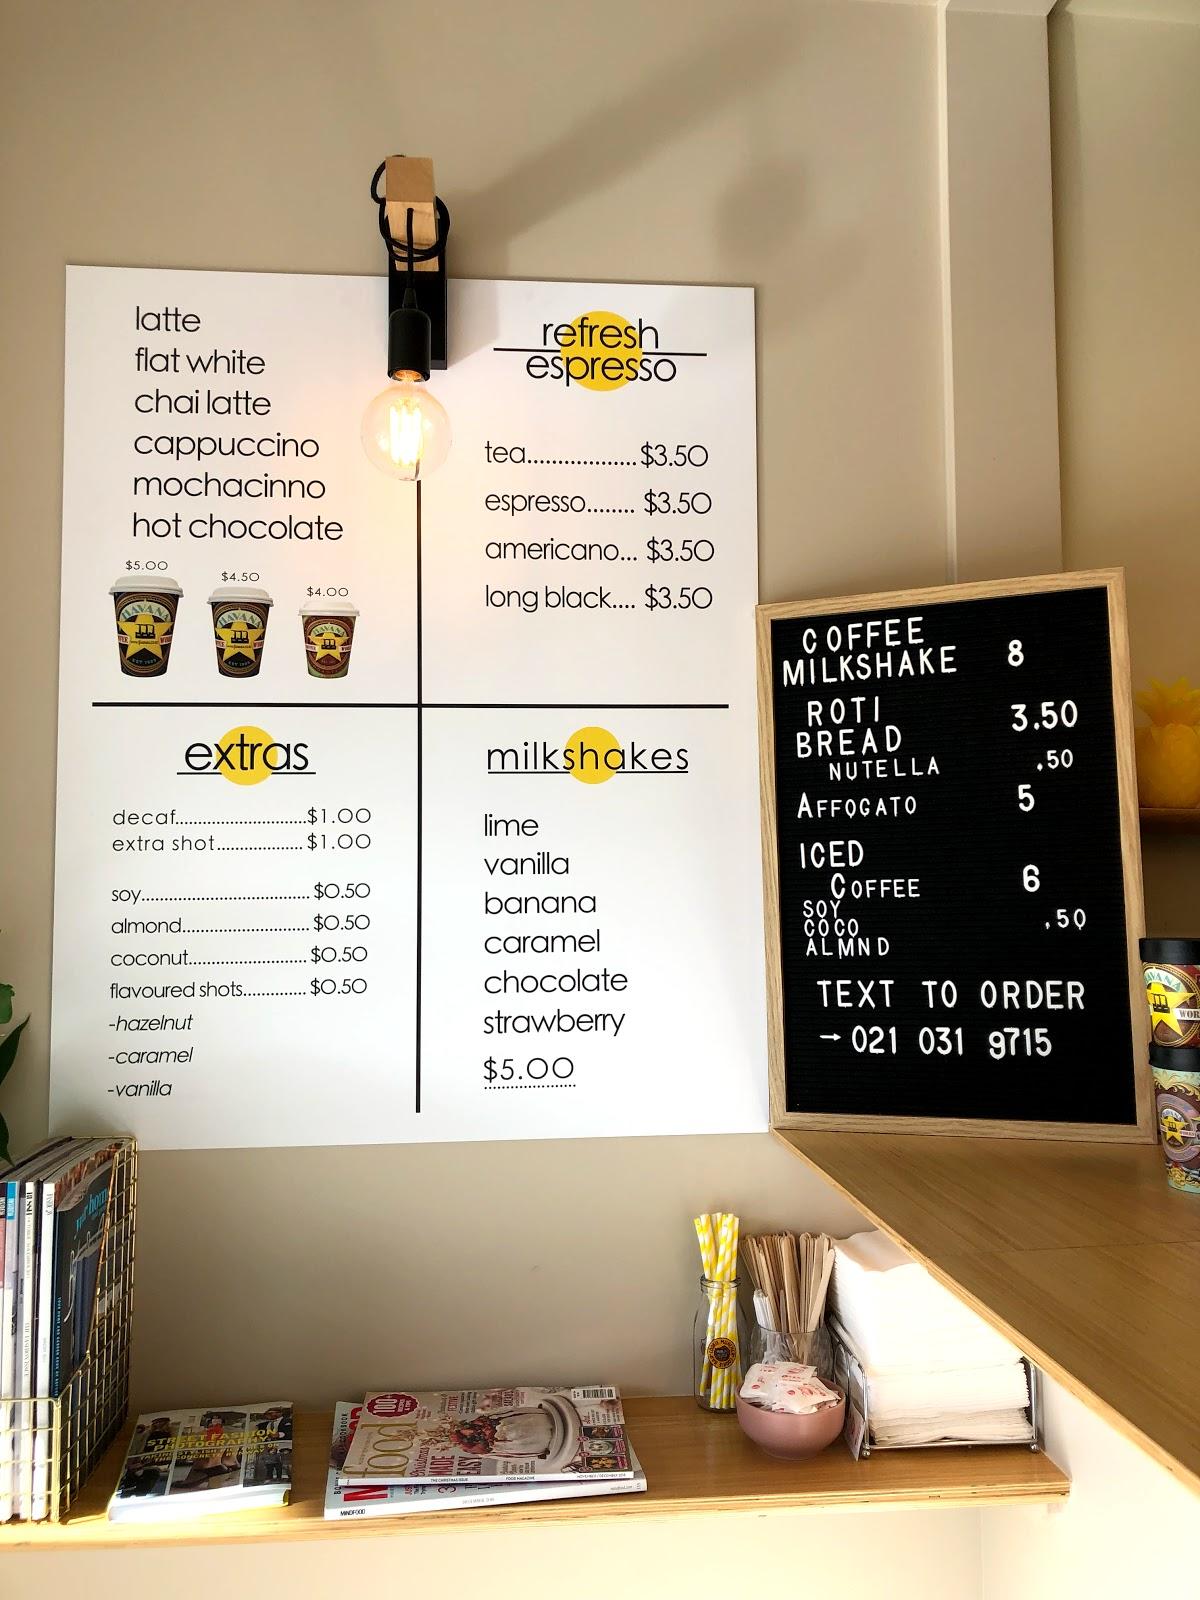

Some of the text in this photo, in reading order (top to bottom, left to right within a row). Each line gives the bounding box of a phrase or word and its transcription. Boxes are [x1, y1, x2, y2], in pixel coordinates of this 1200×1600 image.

[136, 306, 200, 332] latte
[543, 317, 658, 349] refresh
[135, 347, 265, 374] flat white
[526, 354, 677, 387] espresso
[135, 389, 271, 415] chai latte
[134, 432, 319, 461] cappuccino
[641, 441, 708, 468] $3.50
[134, 472, 325, 498] mochacinno
[644, 489, 712, 516] $3.50
[134, 512, 343, 540] hot chocolate
[647, 536, 714, 563] $3.50
[126, 560, 168, 570] $5.00
[222, 571, 259, 581] $4.50
[307, 586, 348, 597] $4.00
[486, 585, 538, 613] long
[645, 584, 712, 611] $3.50
[802, 616, 924, 654] COFFEE
[783, 640, 1024, 687] MILKSHAKE 8
[807, 696, 880, 727] ROTI
[796, 700, 1077, 758] BREAD 3.50
[184, 733, 309, 771] extras
[488, 741, 689, 771] milkshakes
[829, 756, 940, 781] NUTELLA
[1018, 784, 1034, 812] 5
[307, 807, 371, 825] $1.00
[485, 814, 538, 836] lime
[113, 836, 163, 851] extra
[308, 833, 370, 851] $1.00
[801, 840, 863, 869] ICED
[484, 852, 568, 875] vanilla
[314, 882, 370, 900] $0.50
[1023, 864, 1040, 892] 6
[485, 892, 596, 914] banana
[803, 900, 841, 918] SOY
[314, 914, 370, 932] $0.50
[804, 918, 859, 938] COCO
[311, 946, 367, 964] $0.50
[485, 929, 599, 954] caramel
[110, 982, 195, 998] flavoured
[311, 978, 367, 996] $0.50
[485, 968, 628, 994] chocolate
[817, 980, 1084, 1010] TEXT TO ORDER
[484, 1009, 625, 1036] strawberry
[852, 1025, 1051, 1060] 021 031 9715
[484, 1056, 574, 1083] $5.00
[343, 1422, 418, 1478] food
[428, 1456, 455, 1475] MADE
[457, 1456, 482, 1475] EASY
